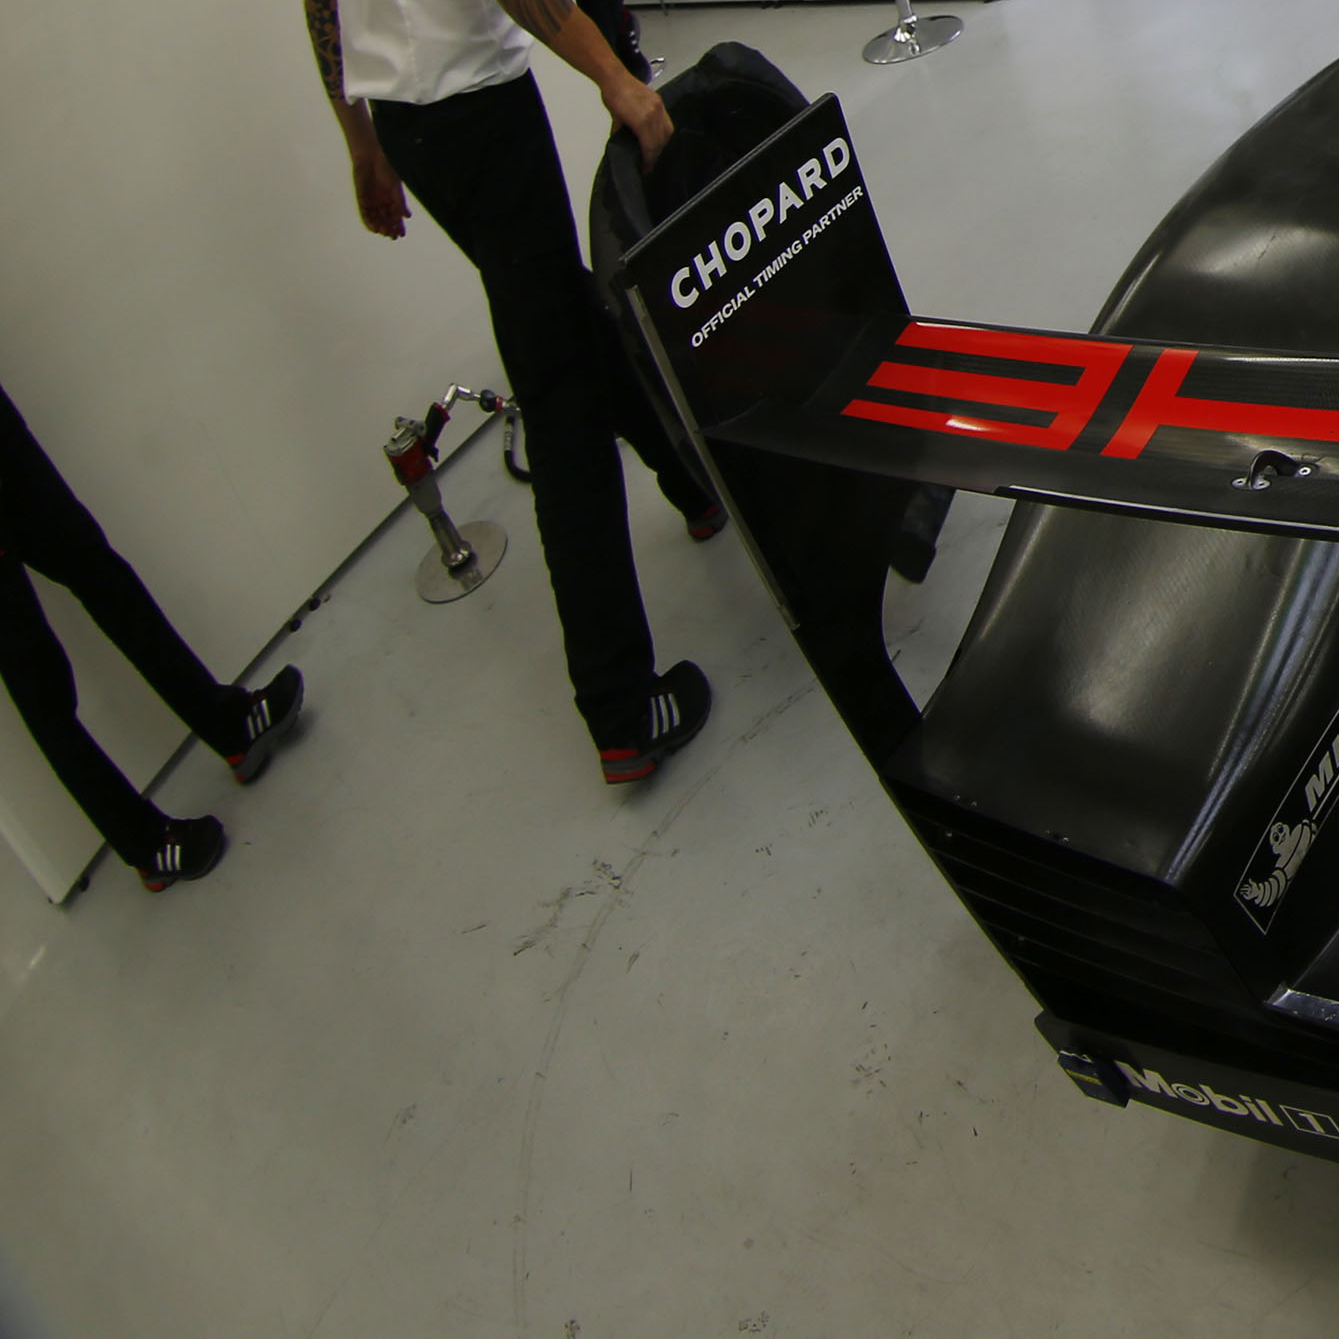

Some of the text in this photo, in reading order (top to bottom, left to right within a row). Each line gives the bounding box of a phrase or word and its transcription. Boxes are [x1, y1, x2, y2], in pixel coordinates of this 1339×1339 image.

[671, 137, 851, 308] CHOPARD
[691, 185, 864, 348] OFFICIAL TIMING PARTNER
[1114, 1060, 1284, 1127] Mobil
